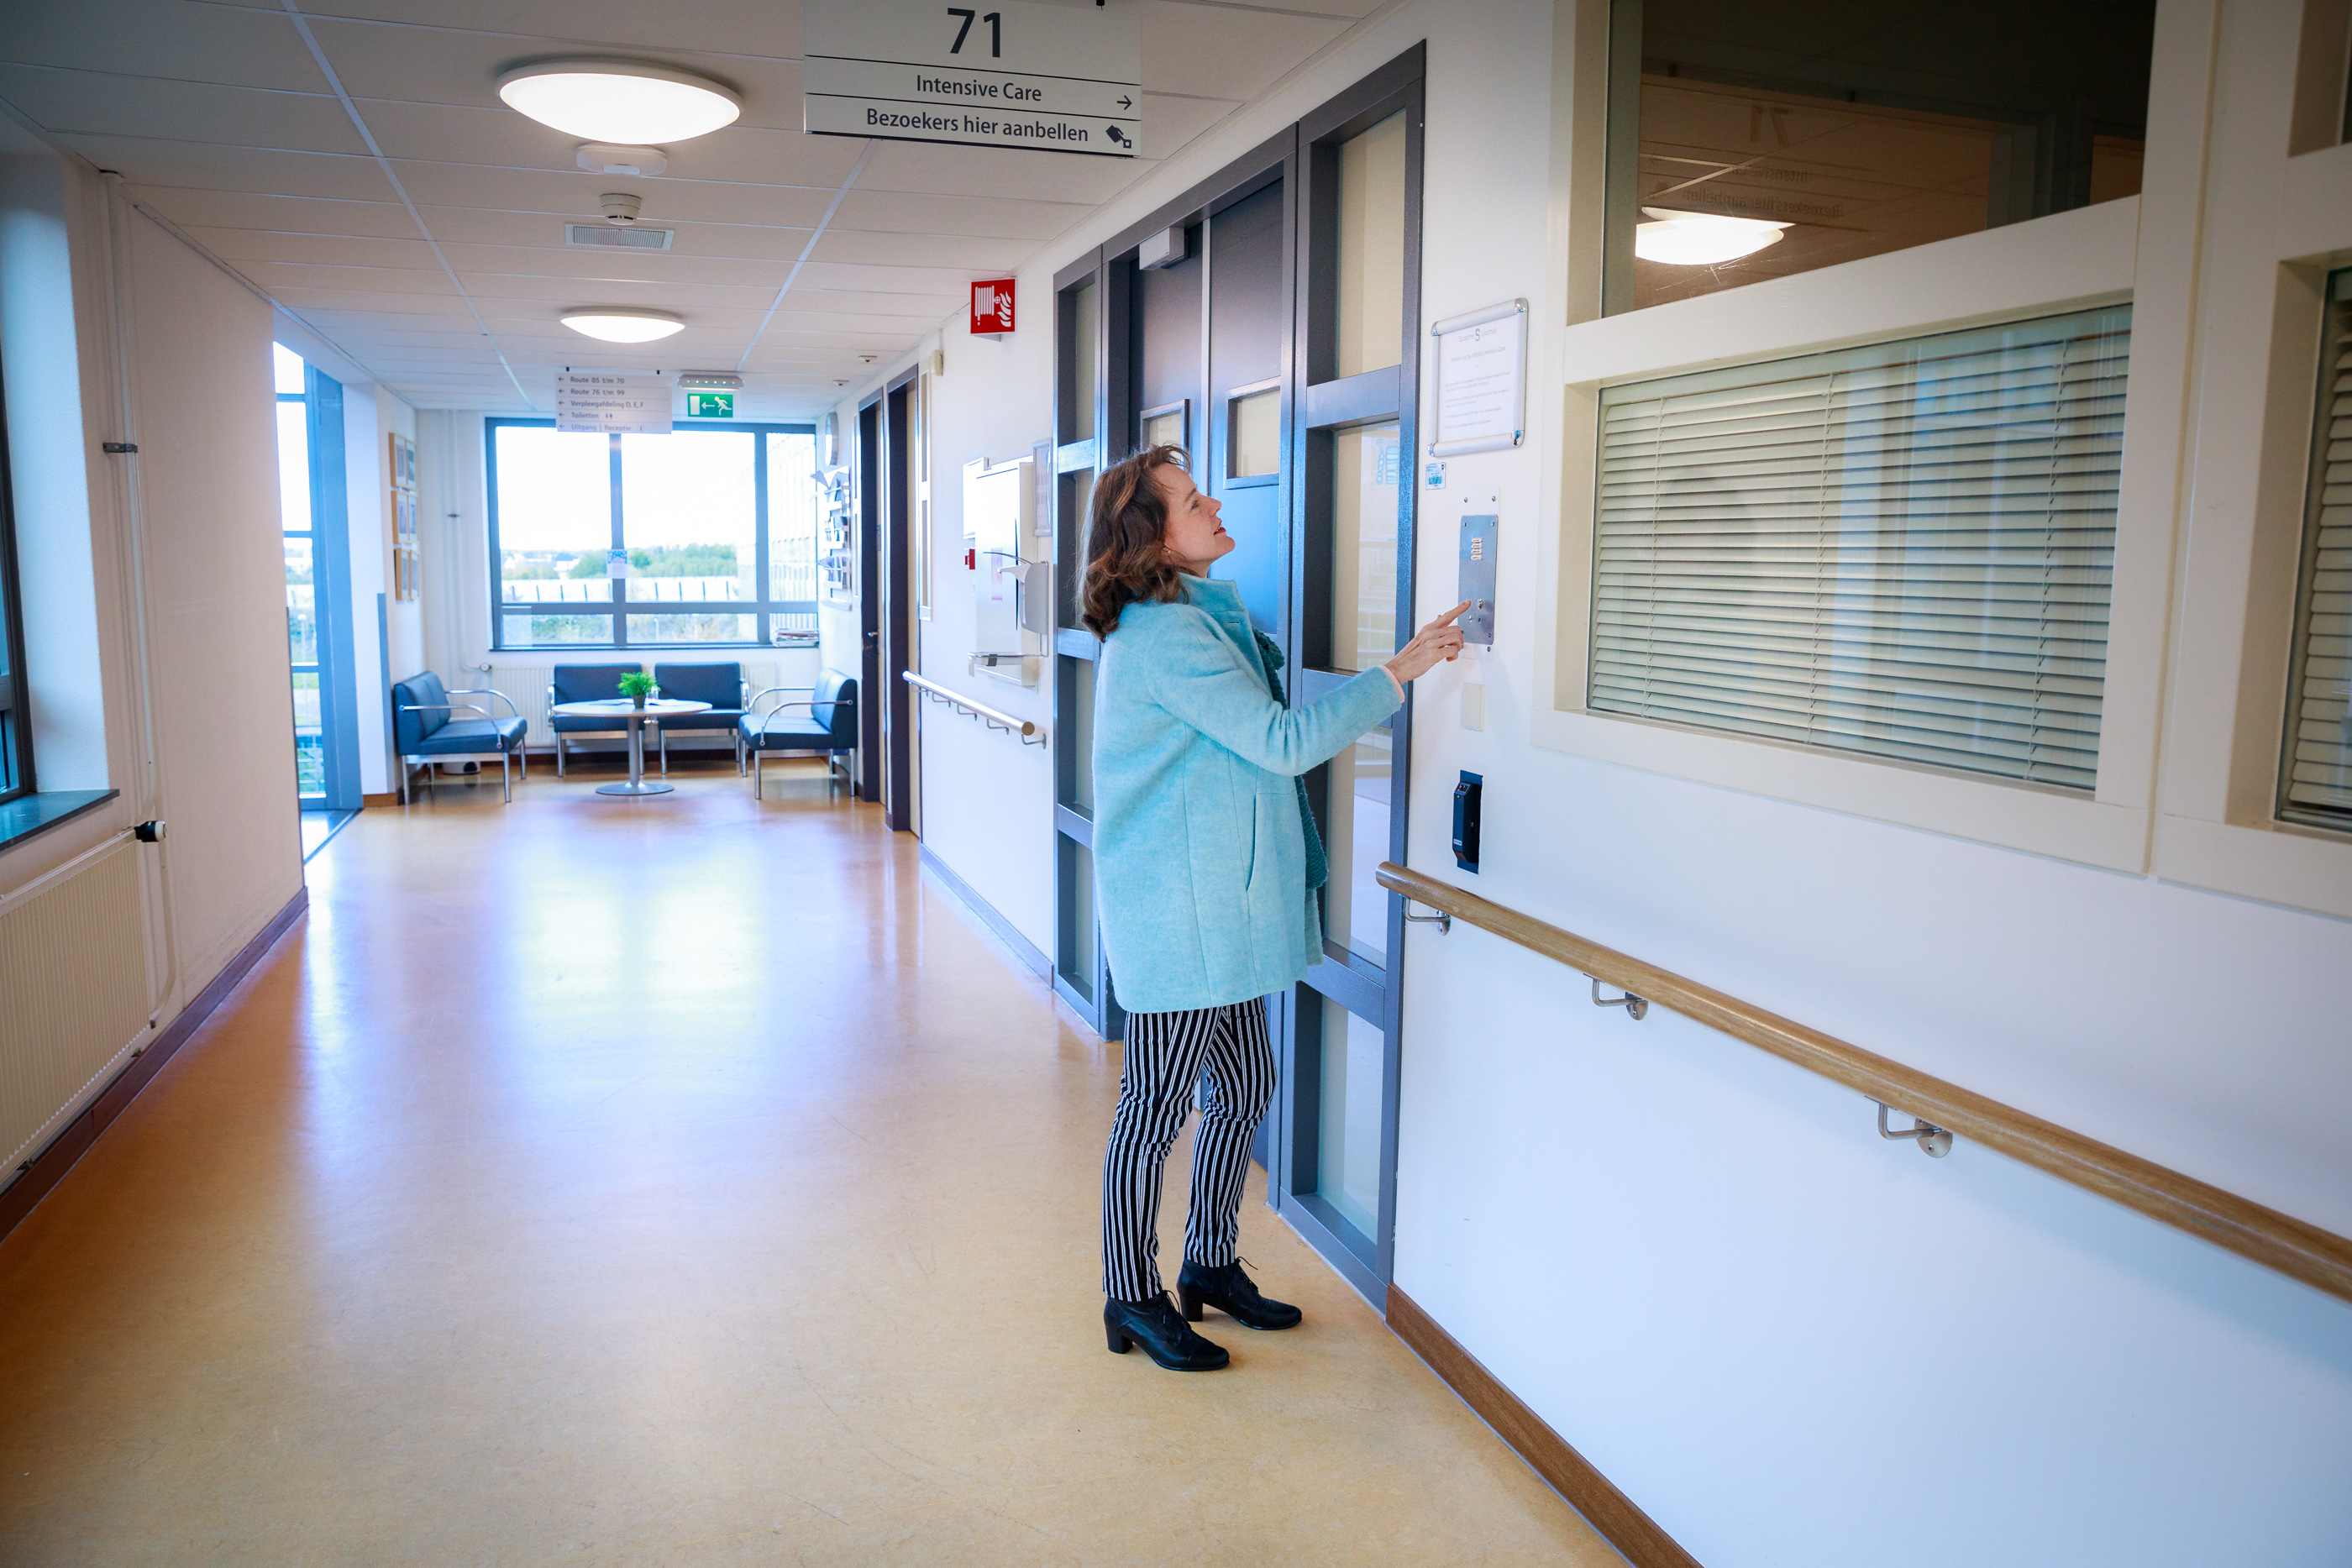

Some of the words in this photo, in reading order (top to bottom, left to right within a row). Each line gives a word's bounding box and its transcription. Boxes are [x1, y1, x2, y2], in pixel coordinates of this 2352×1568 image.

[947, 7, 1001, 58] 71
[916, 74, 998, 98] Intensive
[1003, 81, 1042, 102] Care
[866, 108, 958, 132] Bezoekers
[963, 115, 999, 134] hier
[1002, 122, 1089, 142] aanbellen
[570, 400, 625, 409] Verpleegafdeling
[570, 423, 597, 432] Uitgang
[604, 424, 632, 433] Receptie
